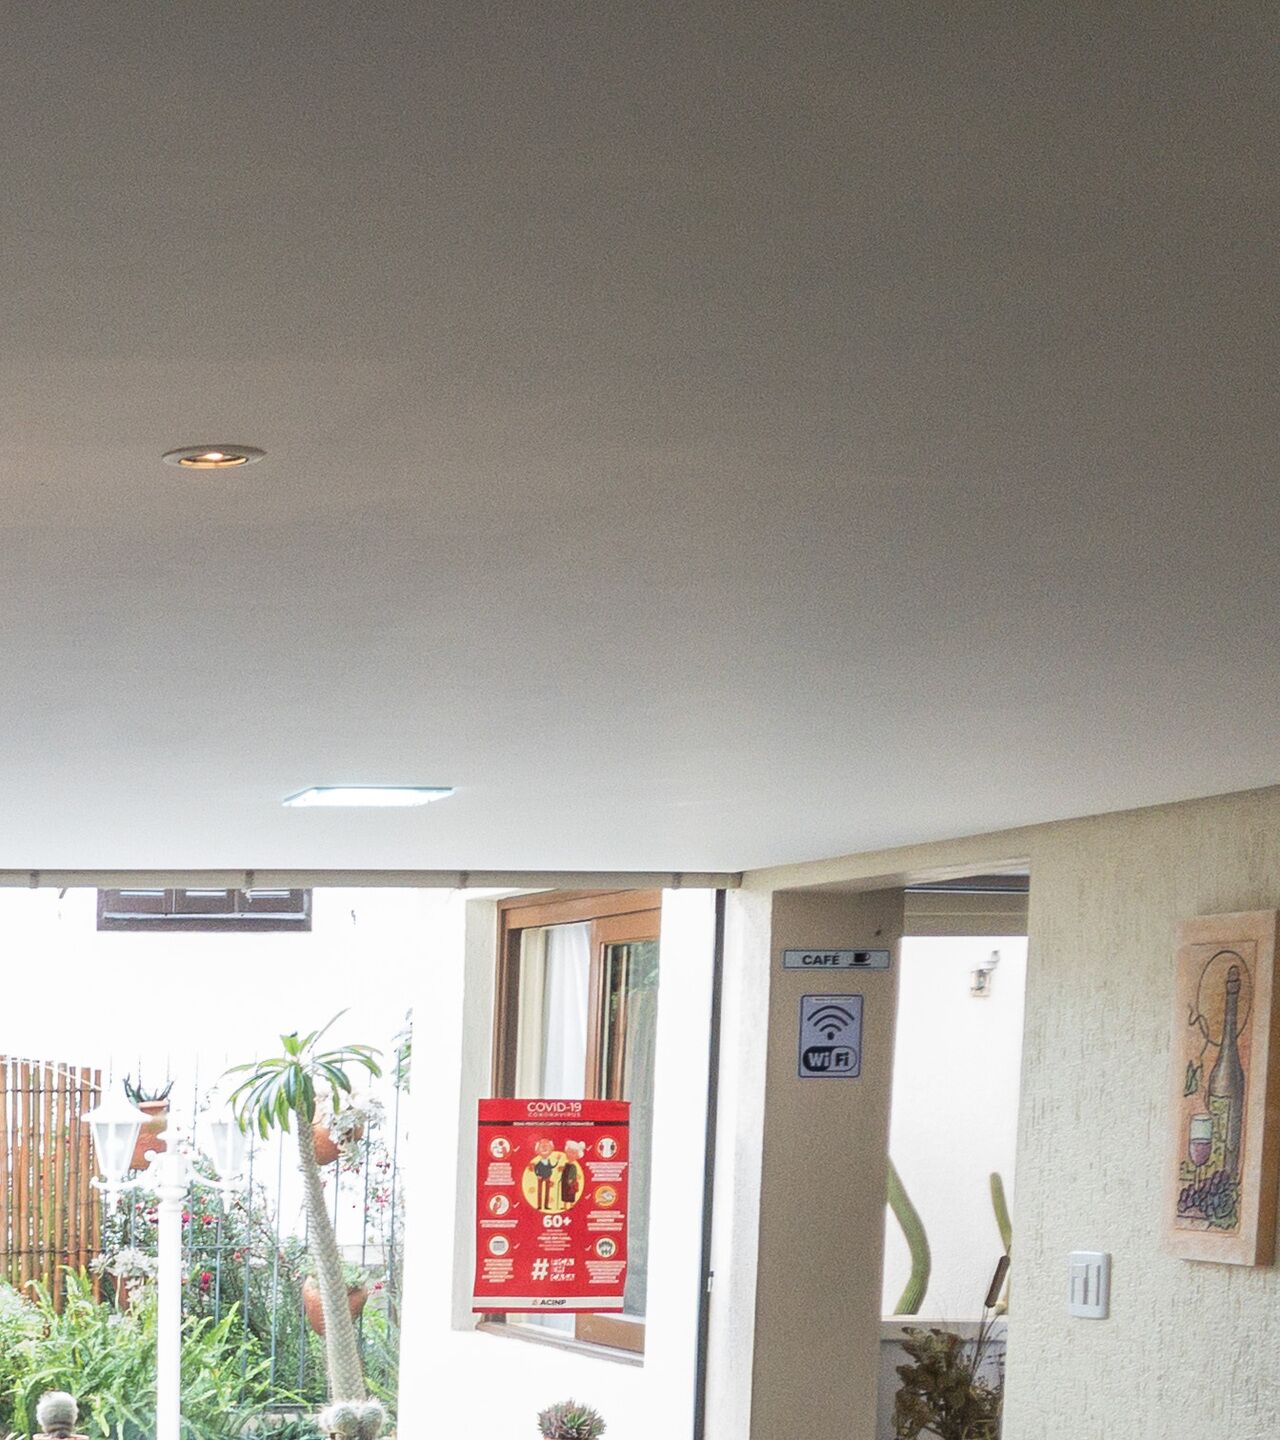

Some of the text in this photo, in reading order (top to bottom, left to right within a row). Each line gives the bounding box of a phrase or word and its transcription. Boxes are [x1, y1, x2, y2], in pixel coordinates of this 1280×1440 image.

[802, 953, 840, 966] CAFÉ
[527, 1102, 582, 1112] COVID-19
[543, 1214, 572, 1228] 60+
